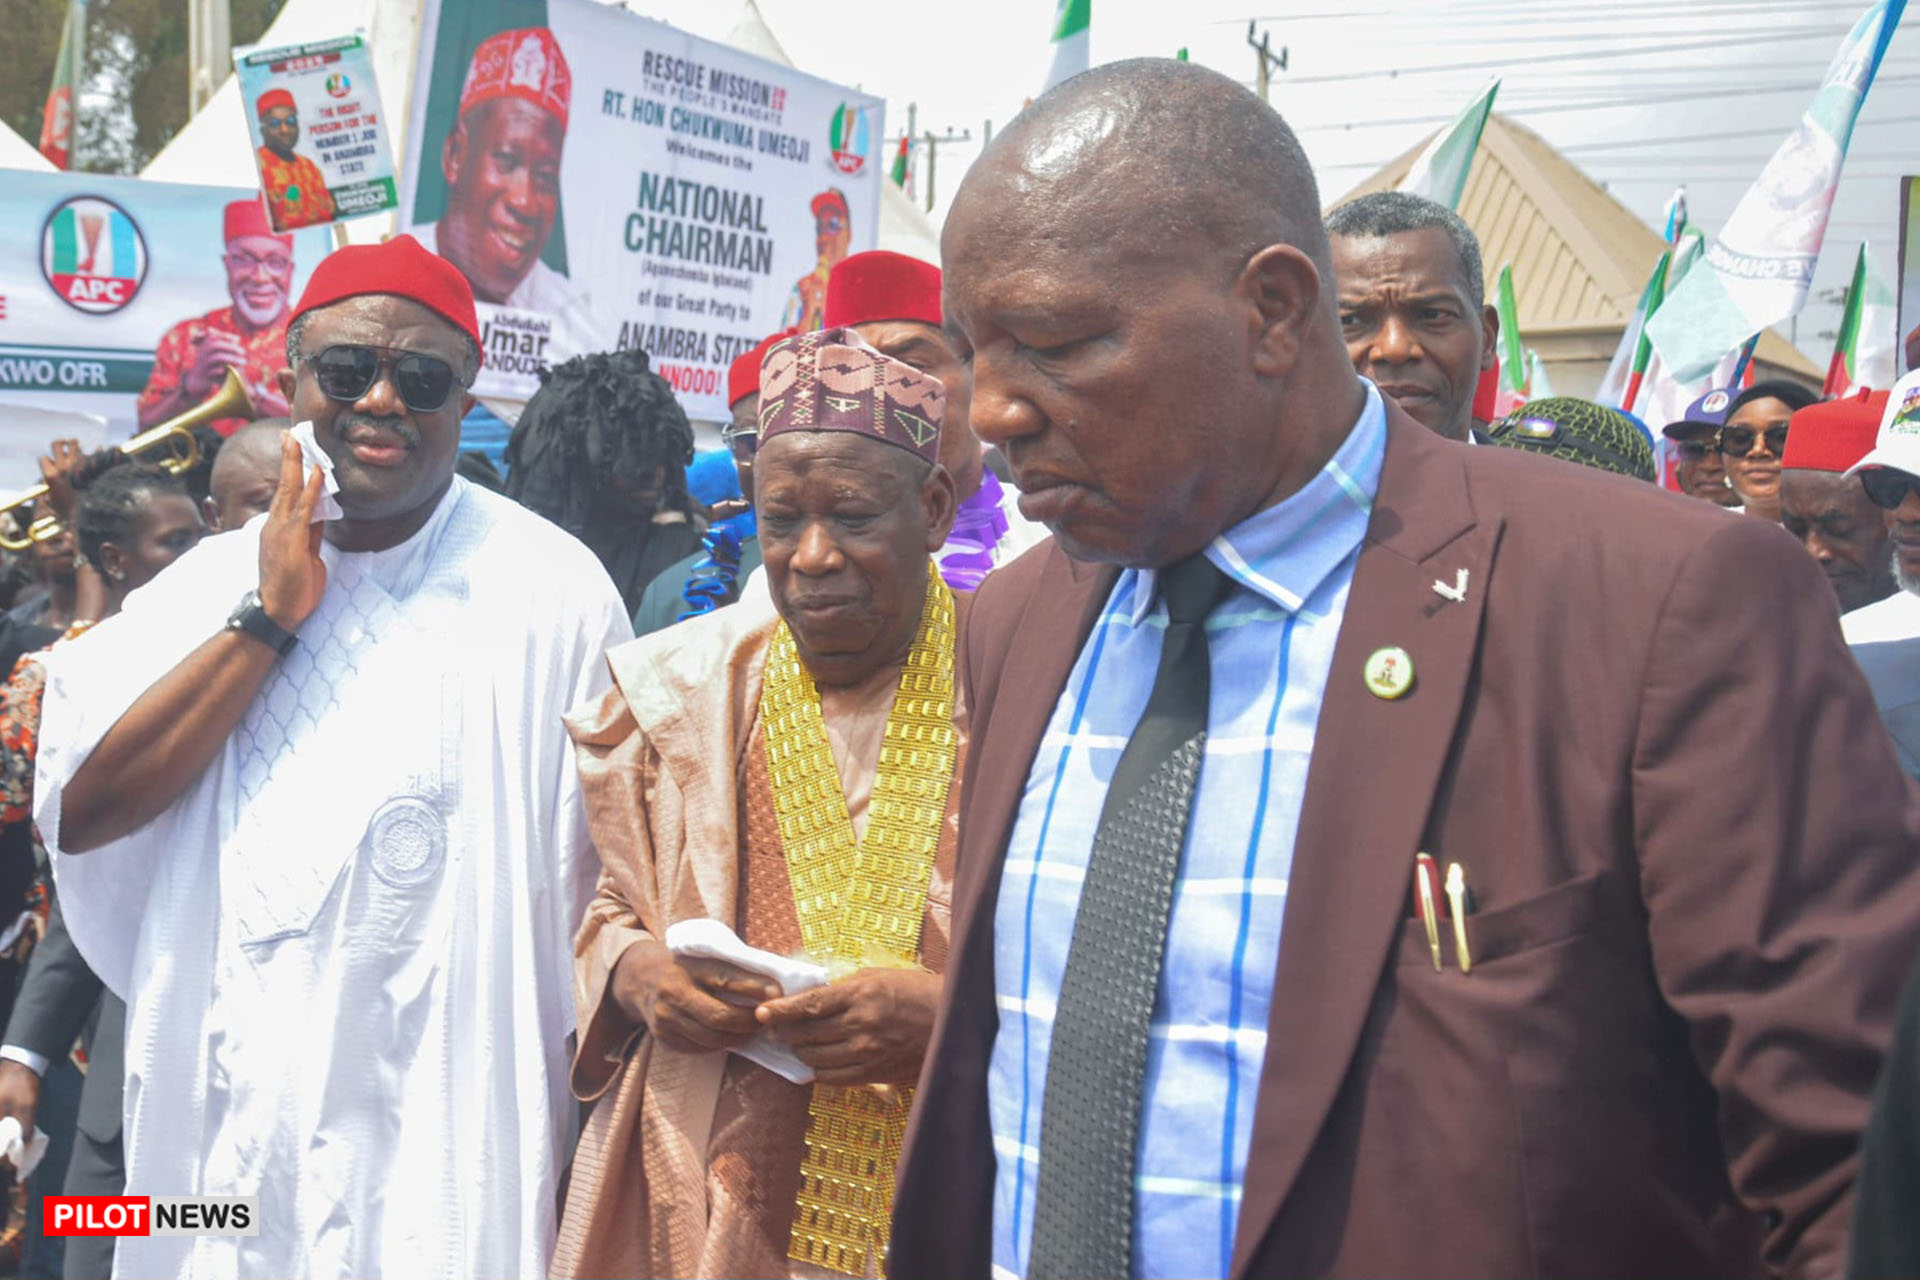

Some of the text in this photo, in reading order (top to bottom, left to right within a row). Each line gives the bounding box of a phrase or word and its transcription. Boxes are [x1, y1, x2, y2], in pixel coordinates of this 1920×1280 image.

[642, 49, 705, 90] RESCUE
[708, 68, 771, 109] MISSION
[643, 79, 664, 94] THE
[602, 89, 810, 164] RT. HON CHUKWUMA UMEOJI
[666, 139, 753, 172] Welcomes the
[637, 171, 767, 233] NATIONAL
[623, 212, 774, 276] CHAIRMAN
[69, 278, 124, 301] APC
[638, 289, 750, 321] of our Great Party to
[616, 321, 707, 363] ANAMBRA
[59, 360, 107, 387] OFR
